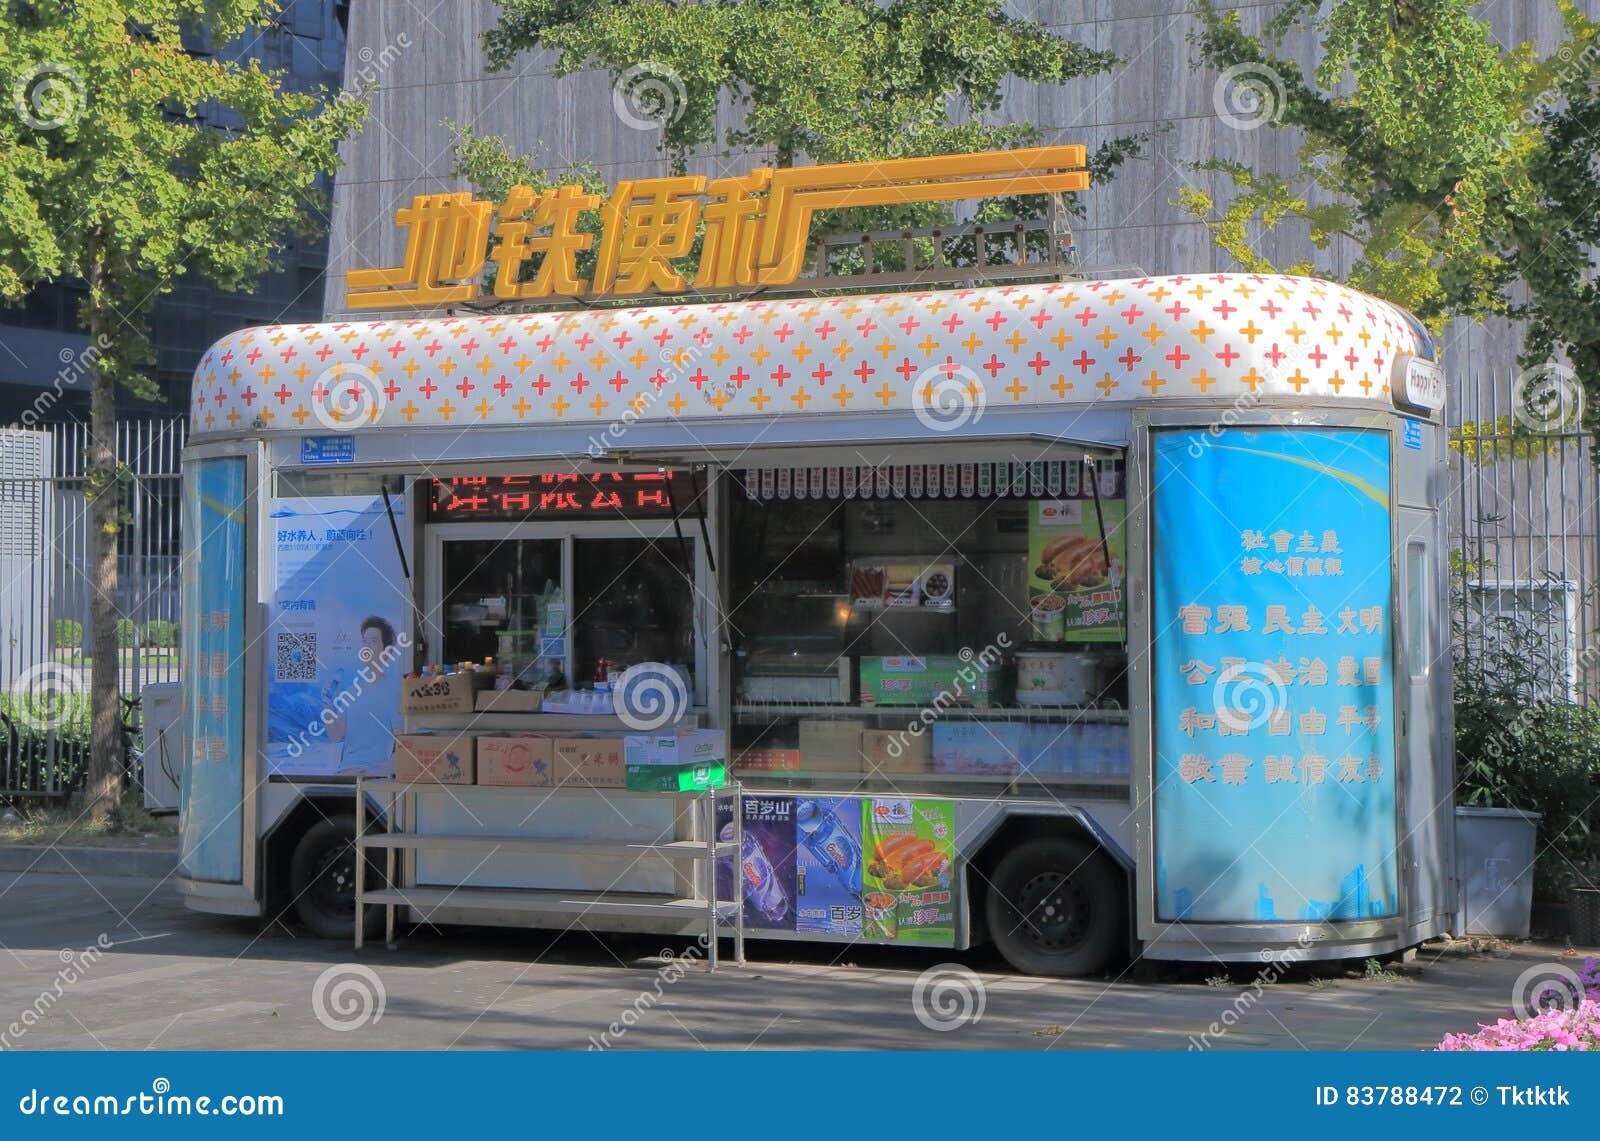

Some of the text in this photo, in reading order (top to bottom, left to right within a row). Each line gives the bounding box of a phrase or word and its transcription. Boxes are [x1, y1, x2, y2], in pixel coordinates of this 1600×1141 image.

[346, 143, 1091, 309] 地铁便利
[1261, 604, 1329, 635] 民主
[1336, 605, 1384, 636] 文明
[1268, 705, 1327, 736] 自由
[744, 800, 790, 815] 百岁山
